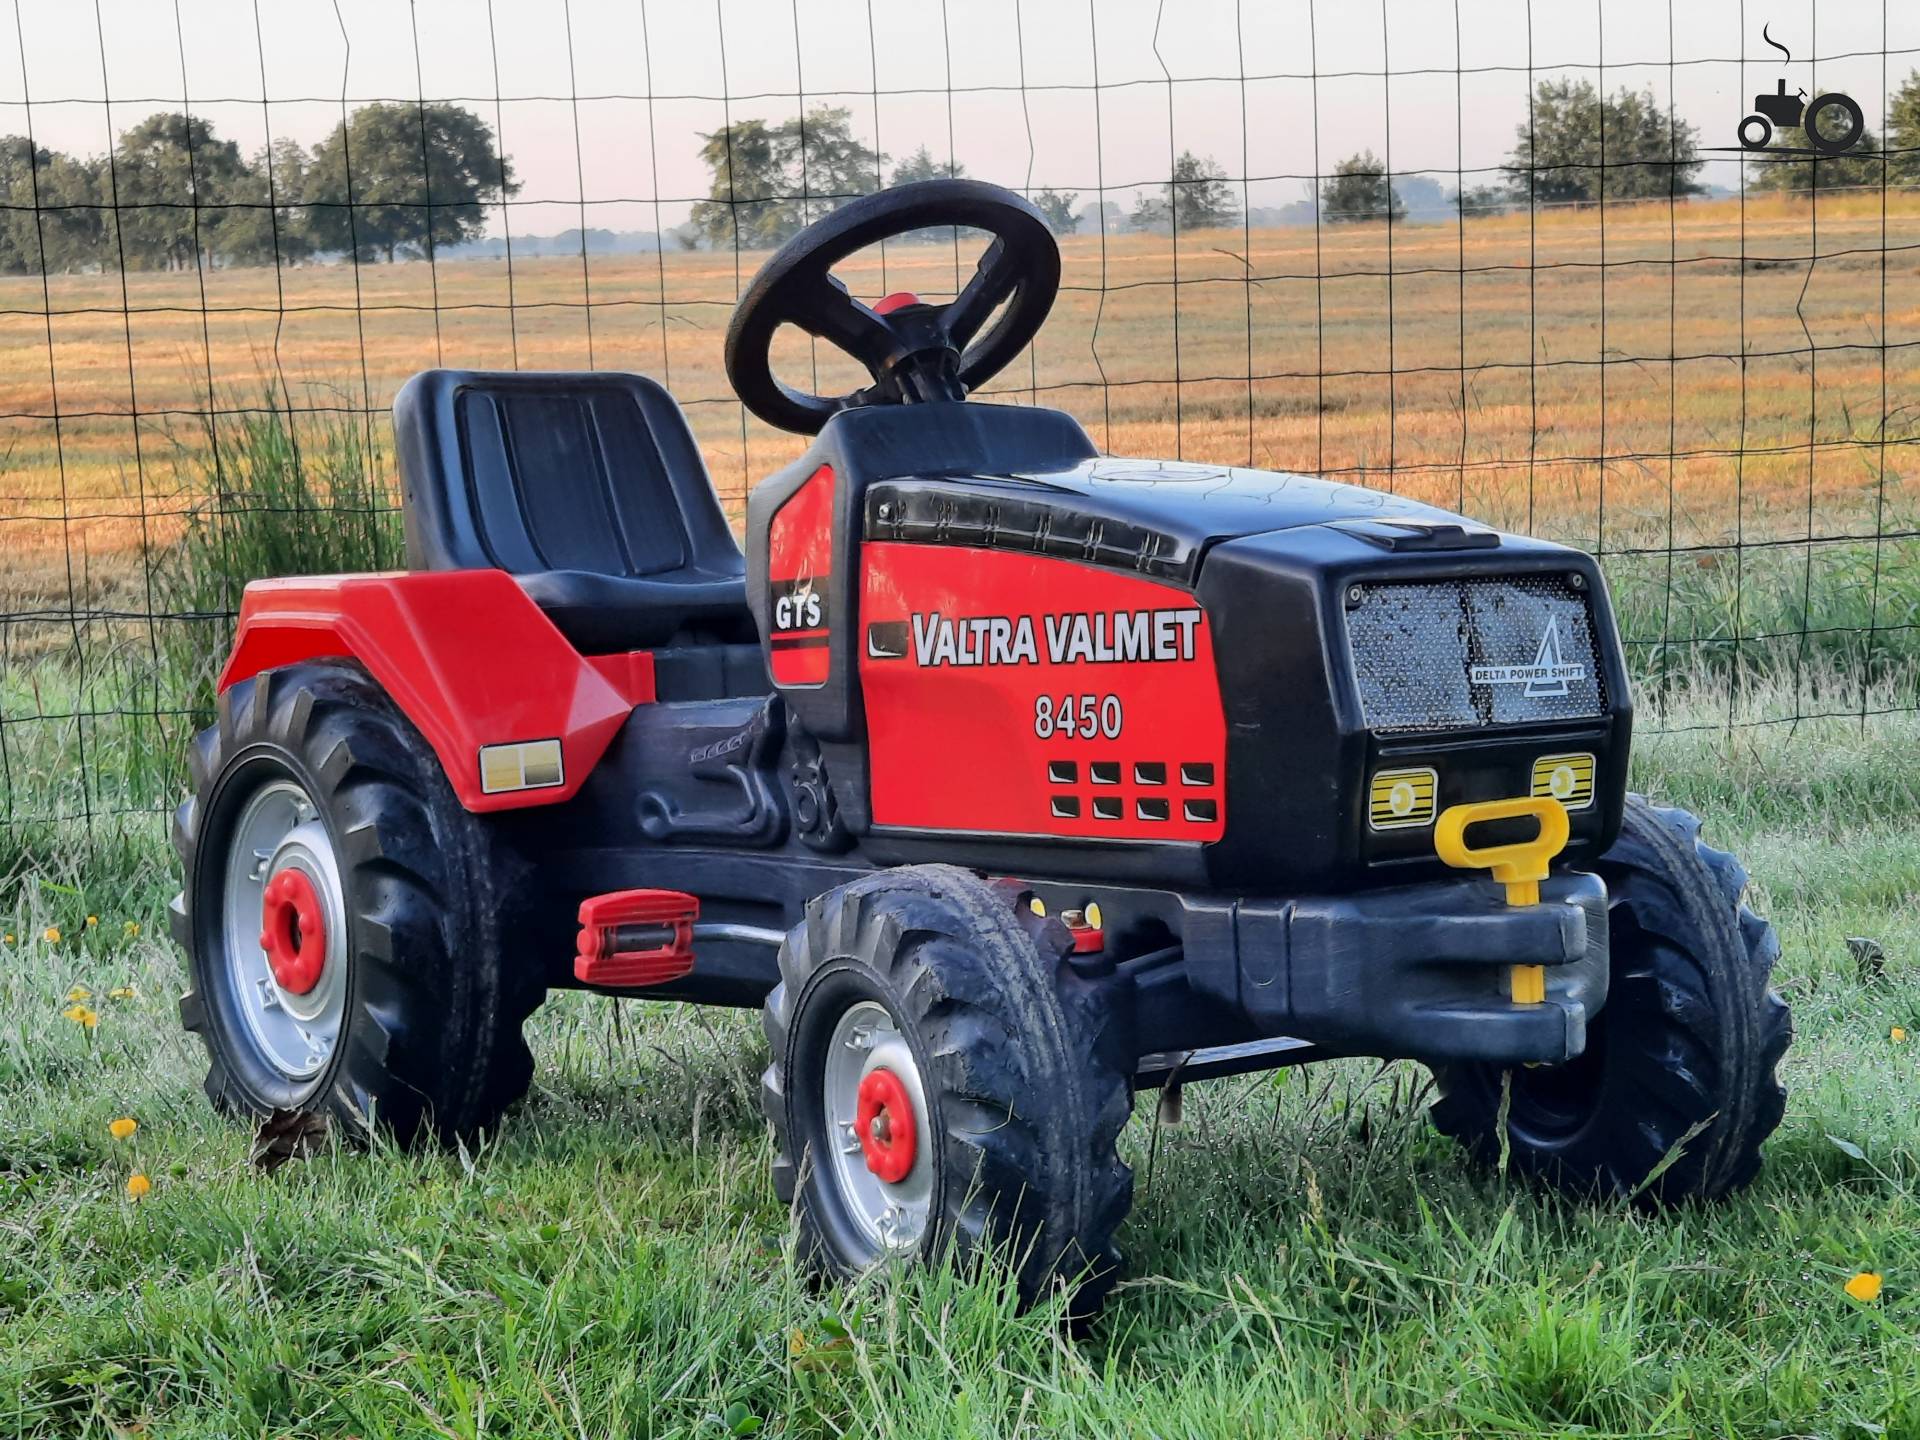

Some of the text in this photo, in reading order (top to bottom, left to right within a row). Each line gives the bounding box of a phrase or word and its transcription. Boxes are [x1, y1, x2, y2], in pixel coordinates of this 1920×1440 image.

[775, 595, 821, 630] GTS
[913, 609, 1200, 667] VALTRA VALMET
[1475, 666, 1582, 681] DELTA POWER SHIFT
[1034, 694, 1124, 740] 8450
